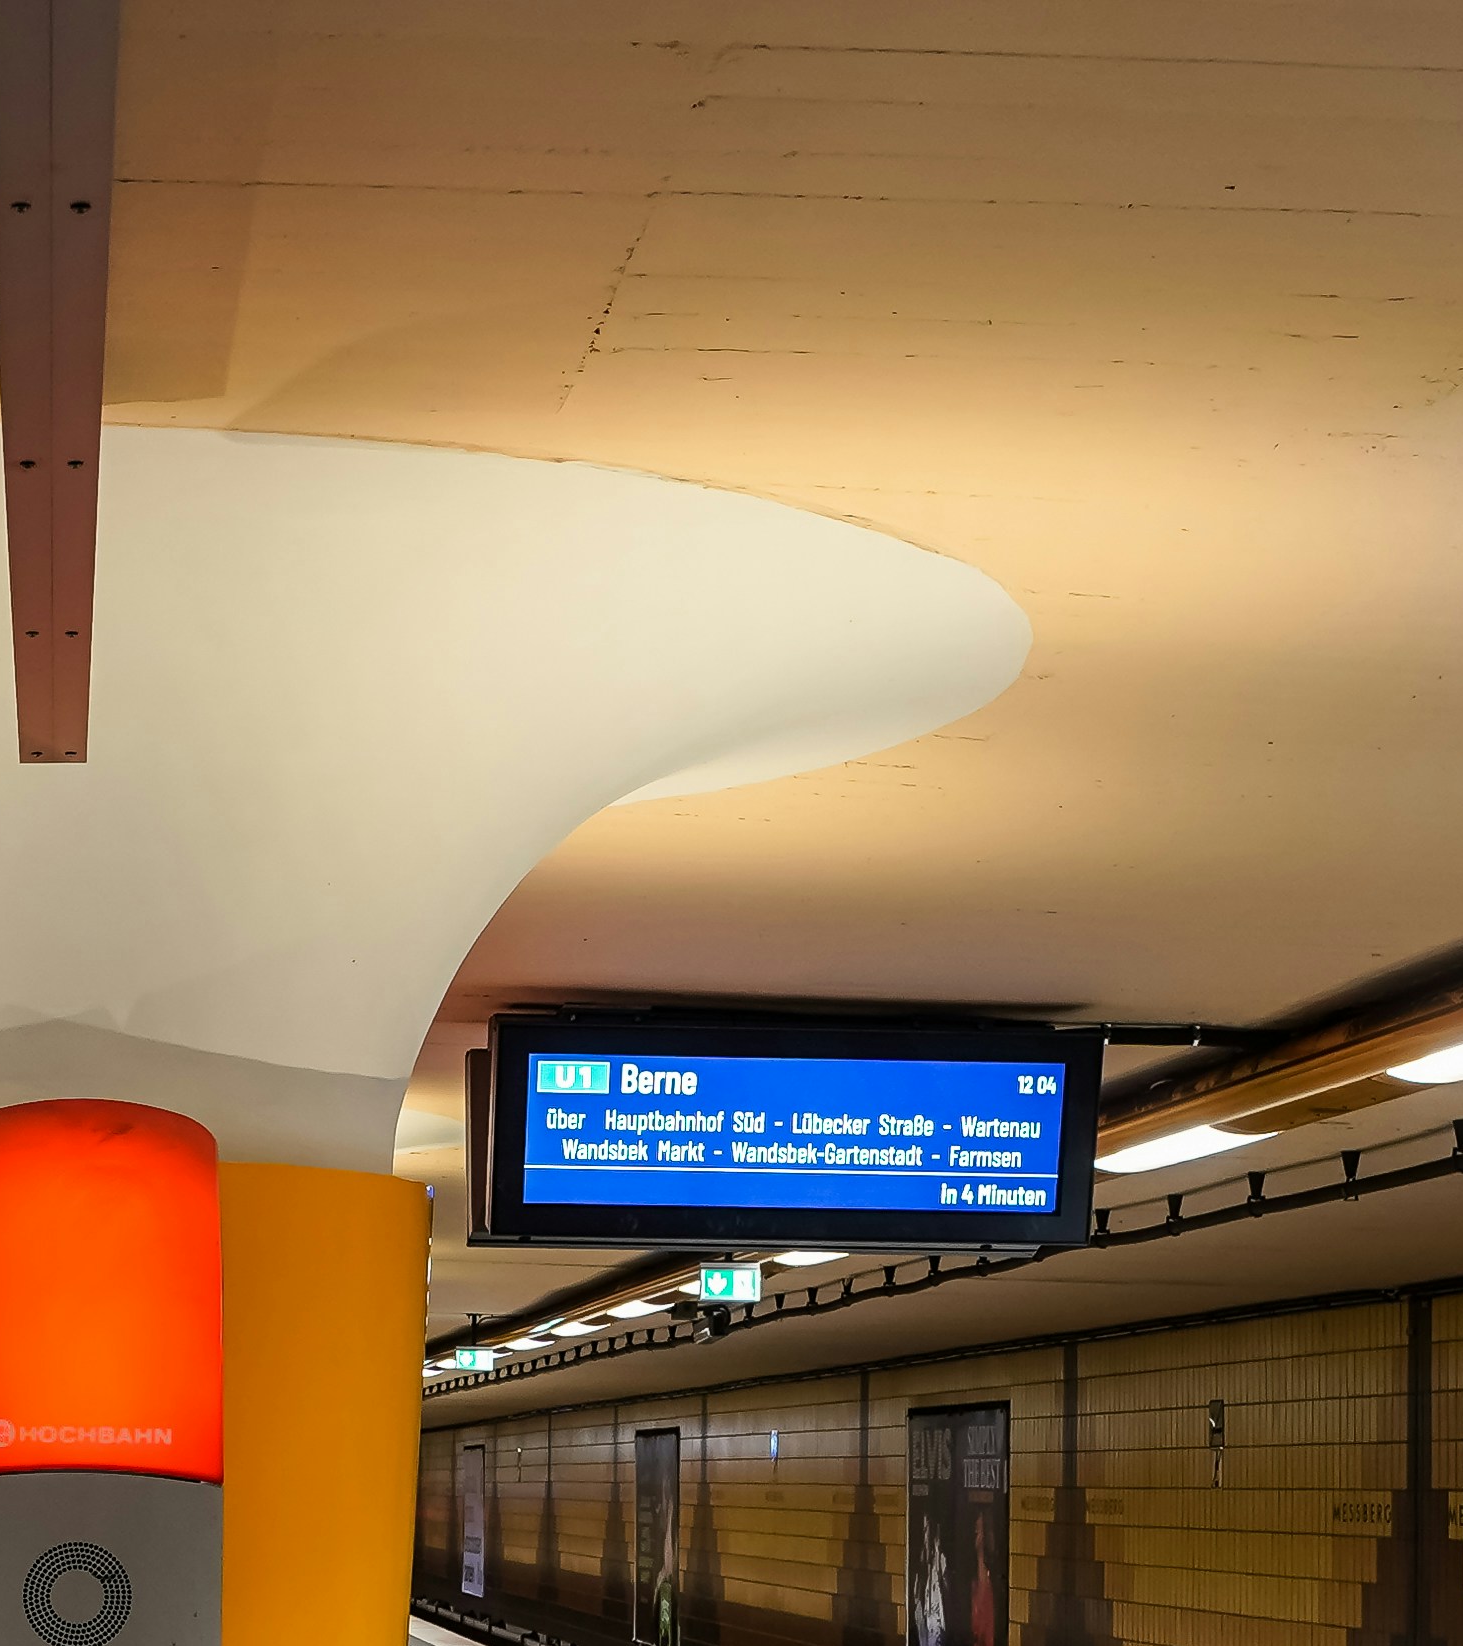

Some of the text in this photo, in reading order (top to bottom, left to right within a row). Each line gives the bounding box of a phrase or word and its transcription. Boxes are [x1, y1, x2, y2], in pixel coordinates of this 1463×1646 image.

[554, 1063, 699, 1096] U1 Berne
[545, 1107, 587, 1130] über
[604, 1109, 725, 1136] Hauptbahnhof
[732, 1111, 766, 1134] Süd
[791, 1112, 871, 1136] Lübecker
[878, 1113, 935, 1137] Straße
[960, 1115, 1041, 1139] Wartenau
[561, 1138, 649, 1161] Wandsbek
[656, 1139, 706, 1163] Markt
[731, 1141, 923, 1167] Wandsbek-Gartenstadt
[948, 1145, 1022, 1169] Farmsen
[939, 1182, 1047, 1207] in 4 Minuten
[19, 1425, 173, 1446] HOCHBAHN
[1332, 1501, 1392, 1524] MESSBERG
